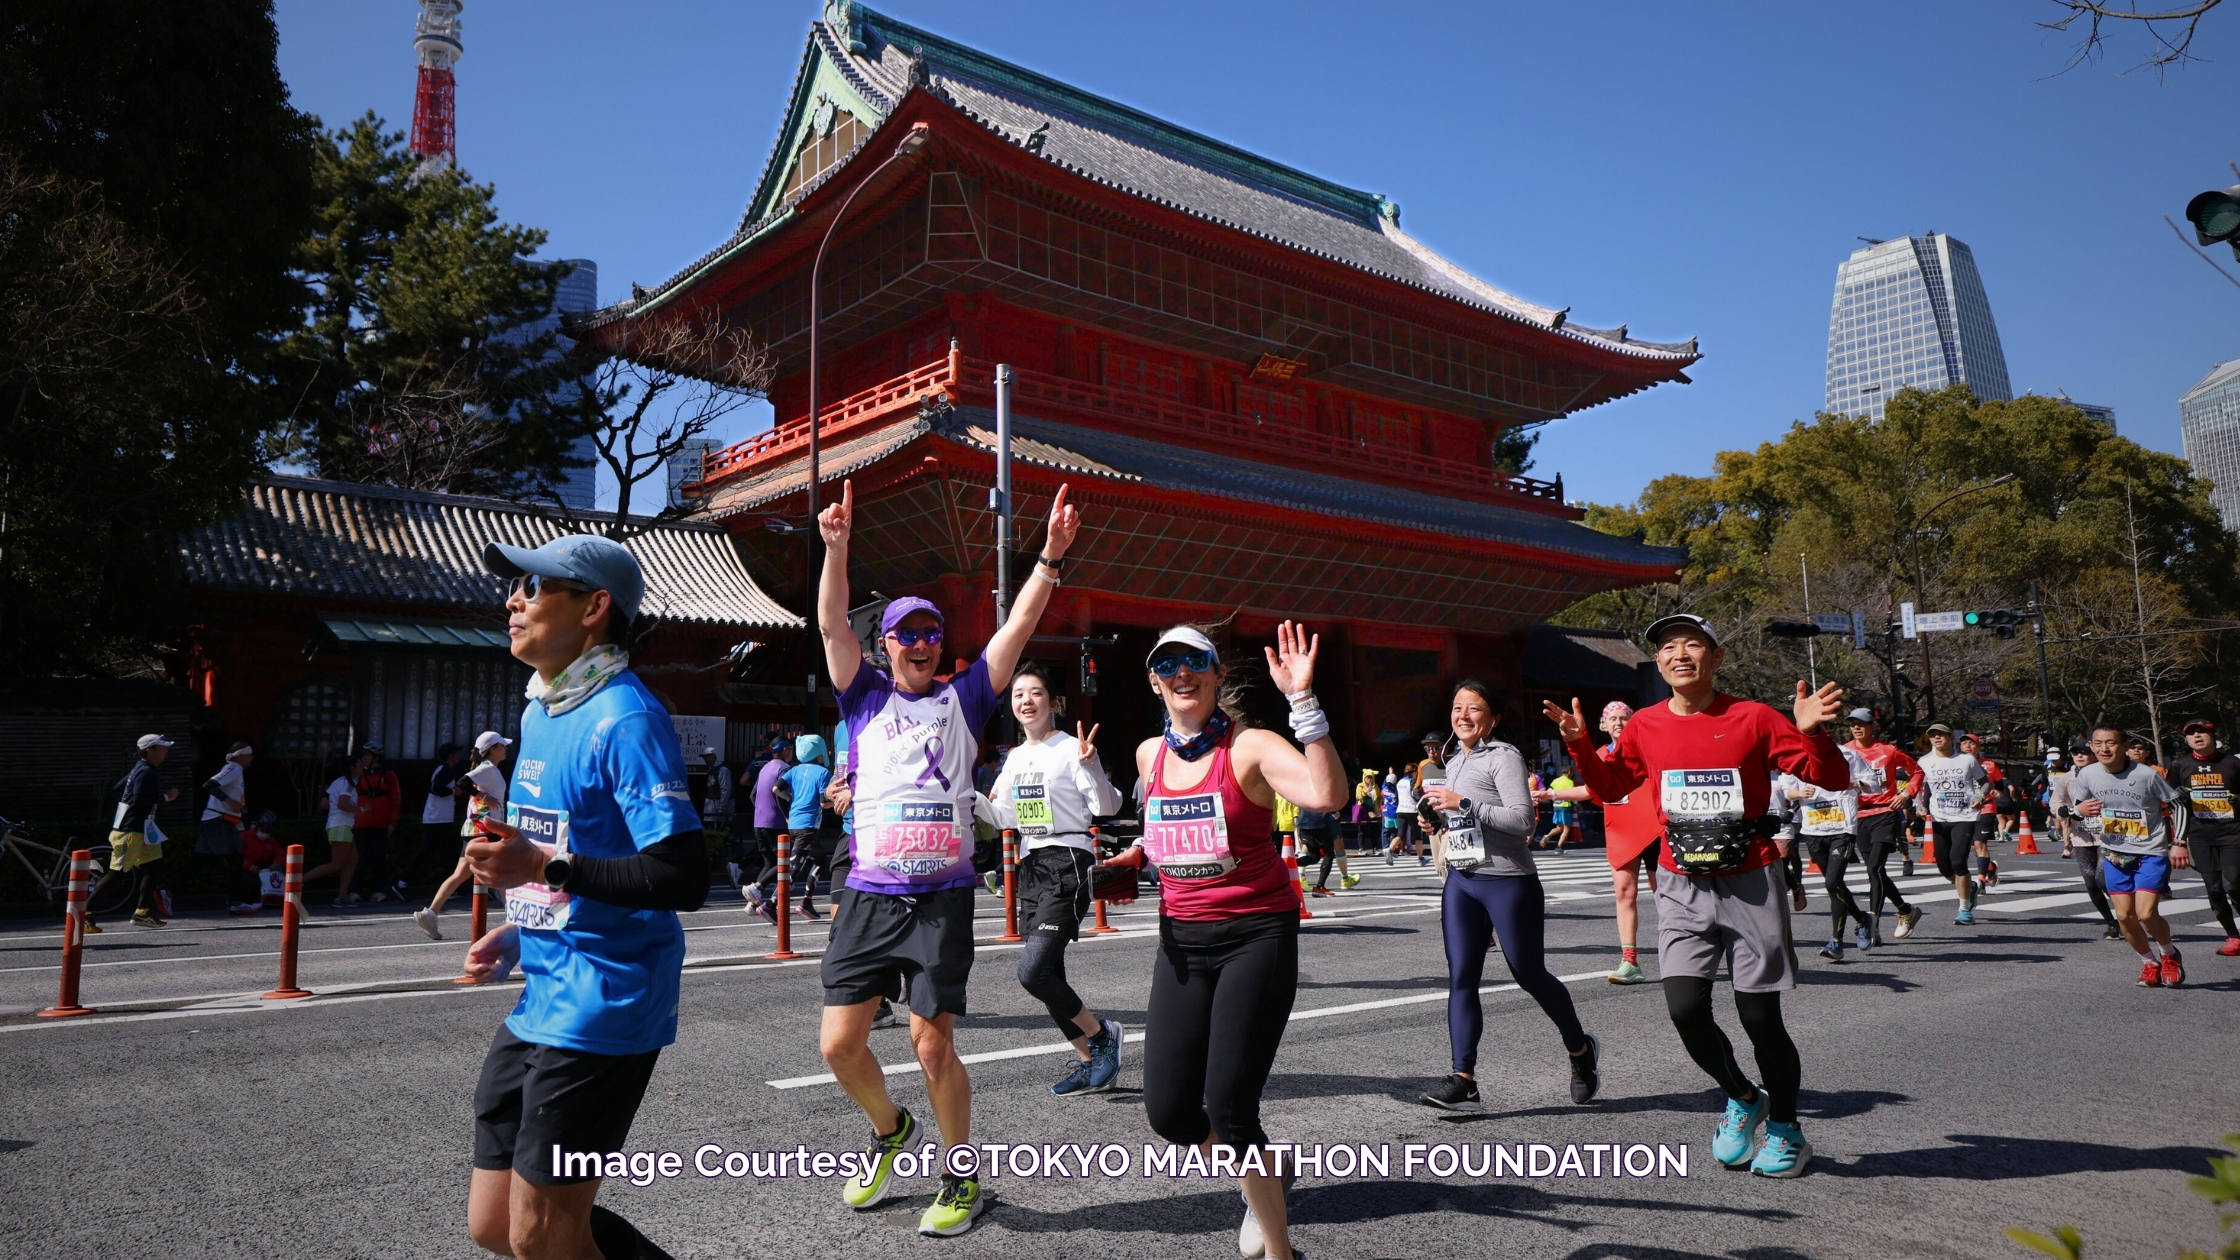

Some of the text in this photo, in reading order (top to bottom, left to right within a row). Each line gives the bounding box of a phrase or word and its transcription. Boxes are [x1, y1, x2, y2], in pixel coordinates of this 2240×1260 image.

[912, 716, 946, 743] purple
[1687, 774, 1731, 783] 東京メトロ
[1931, 768, 1964, 776] TOKYO
[1933, 780, 1965, 790] 2016
[1666, 793, 1673, 802] J
[1680, 790, 1732, 811] 82902
[2096, 788, 2142, 801] TOKYO 2020
[1017, 802, 1045, 819] 50903
[1162, 802, 1211, 816] 東京メトロ
[2199, 800, 2227, 810] 30543
[905, 807, 951, 817] 東京メトロ
[894, 826, 950, 851] 75032
[1145, 827, 1154, 841] G
[1157, 824, 1214, 854] 77470
[1149, 850, 1156, 861] 2
